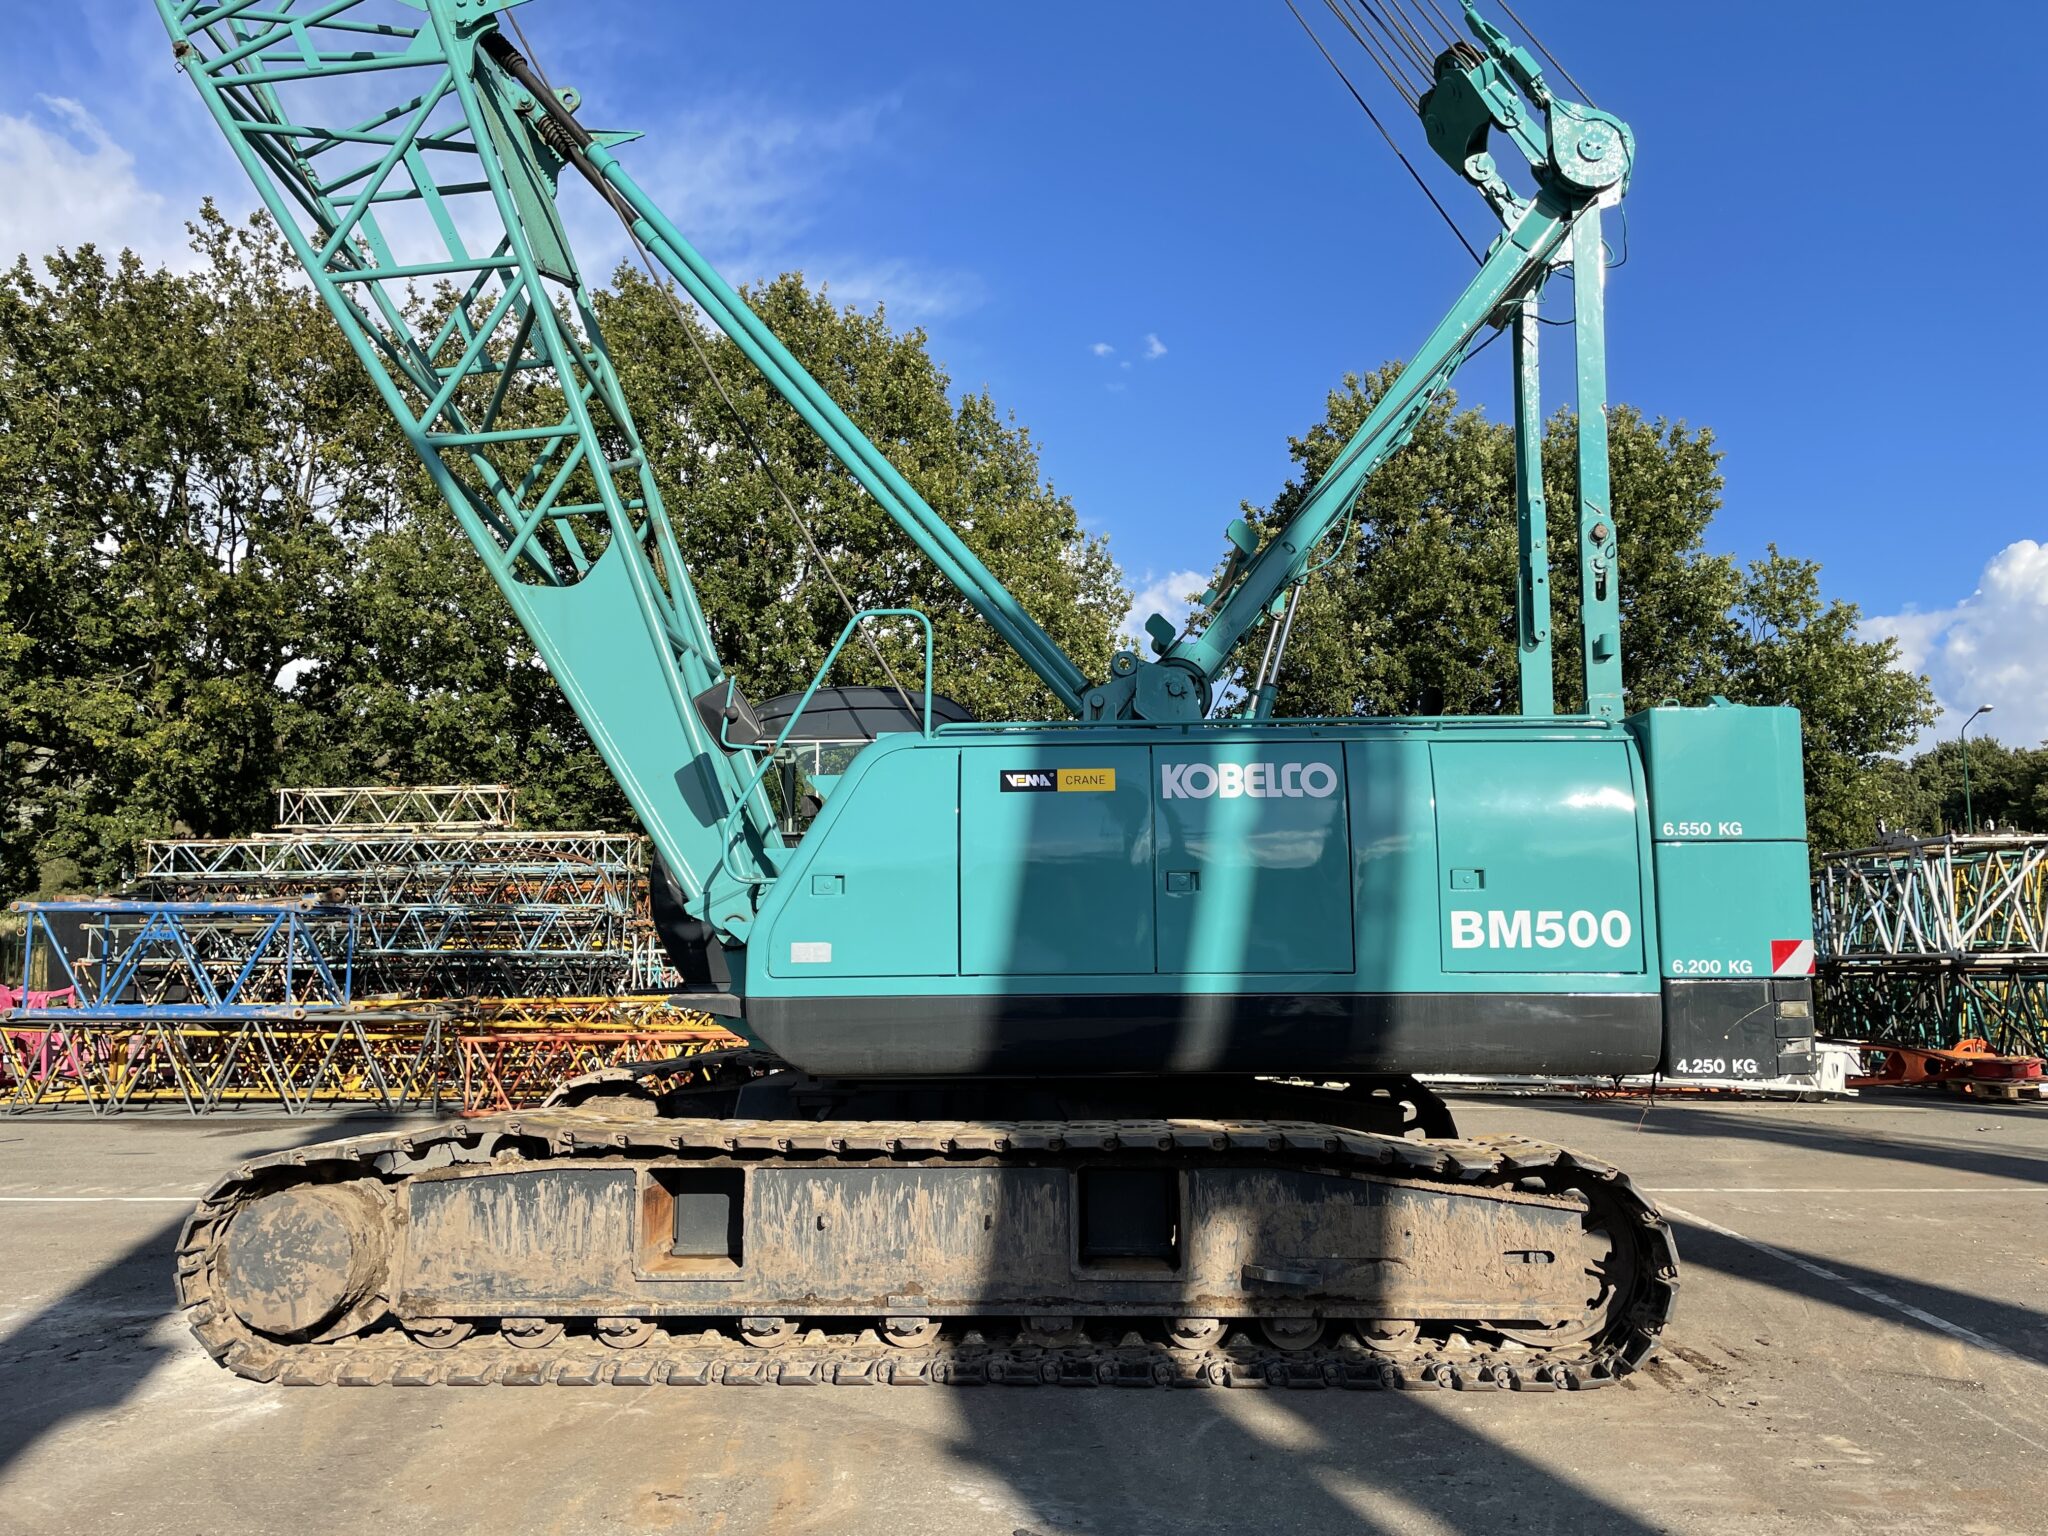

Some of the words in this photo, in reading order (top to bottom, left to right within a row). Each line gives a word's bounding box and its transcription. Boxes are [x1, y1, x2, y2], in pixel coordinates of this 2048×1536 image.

[1065, 775, 1106, 785] CRANE
[1161, 762, 1338, 799] KOBELCO
[1662, 821, 1712, 836] 6.550
[1718, 821, 1743, 836] KG
[1450, 909, 1632, 949] BM500
[1672, 959, 1722, 974] 6.200
[1728, 959, 1753, 974] KG
[1676, 1058, 1726, 1074] 4.250
[1732, 1058, 1757, 1074] KG
